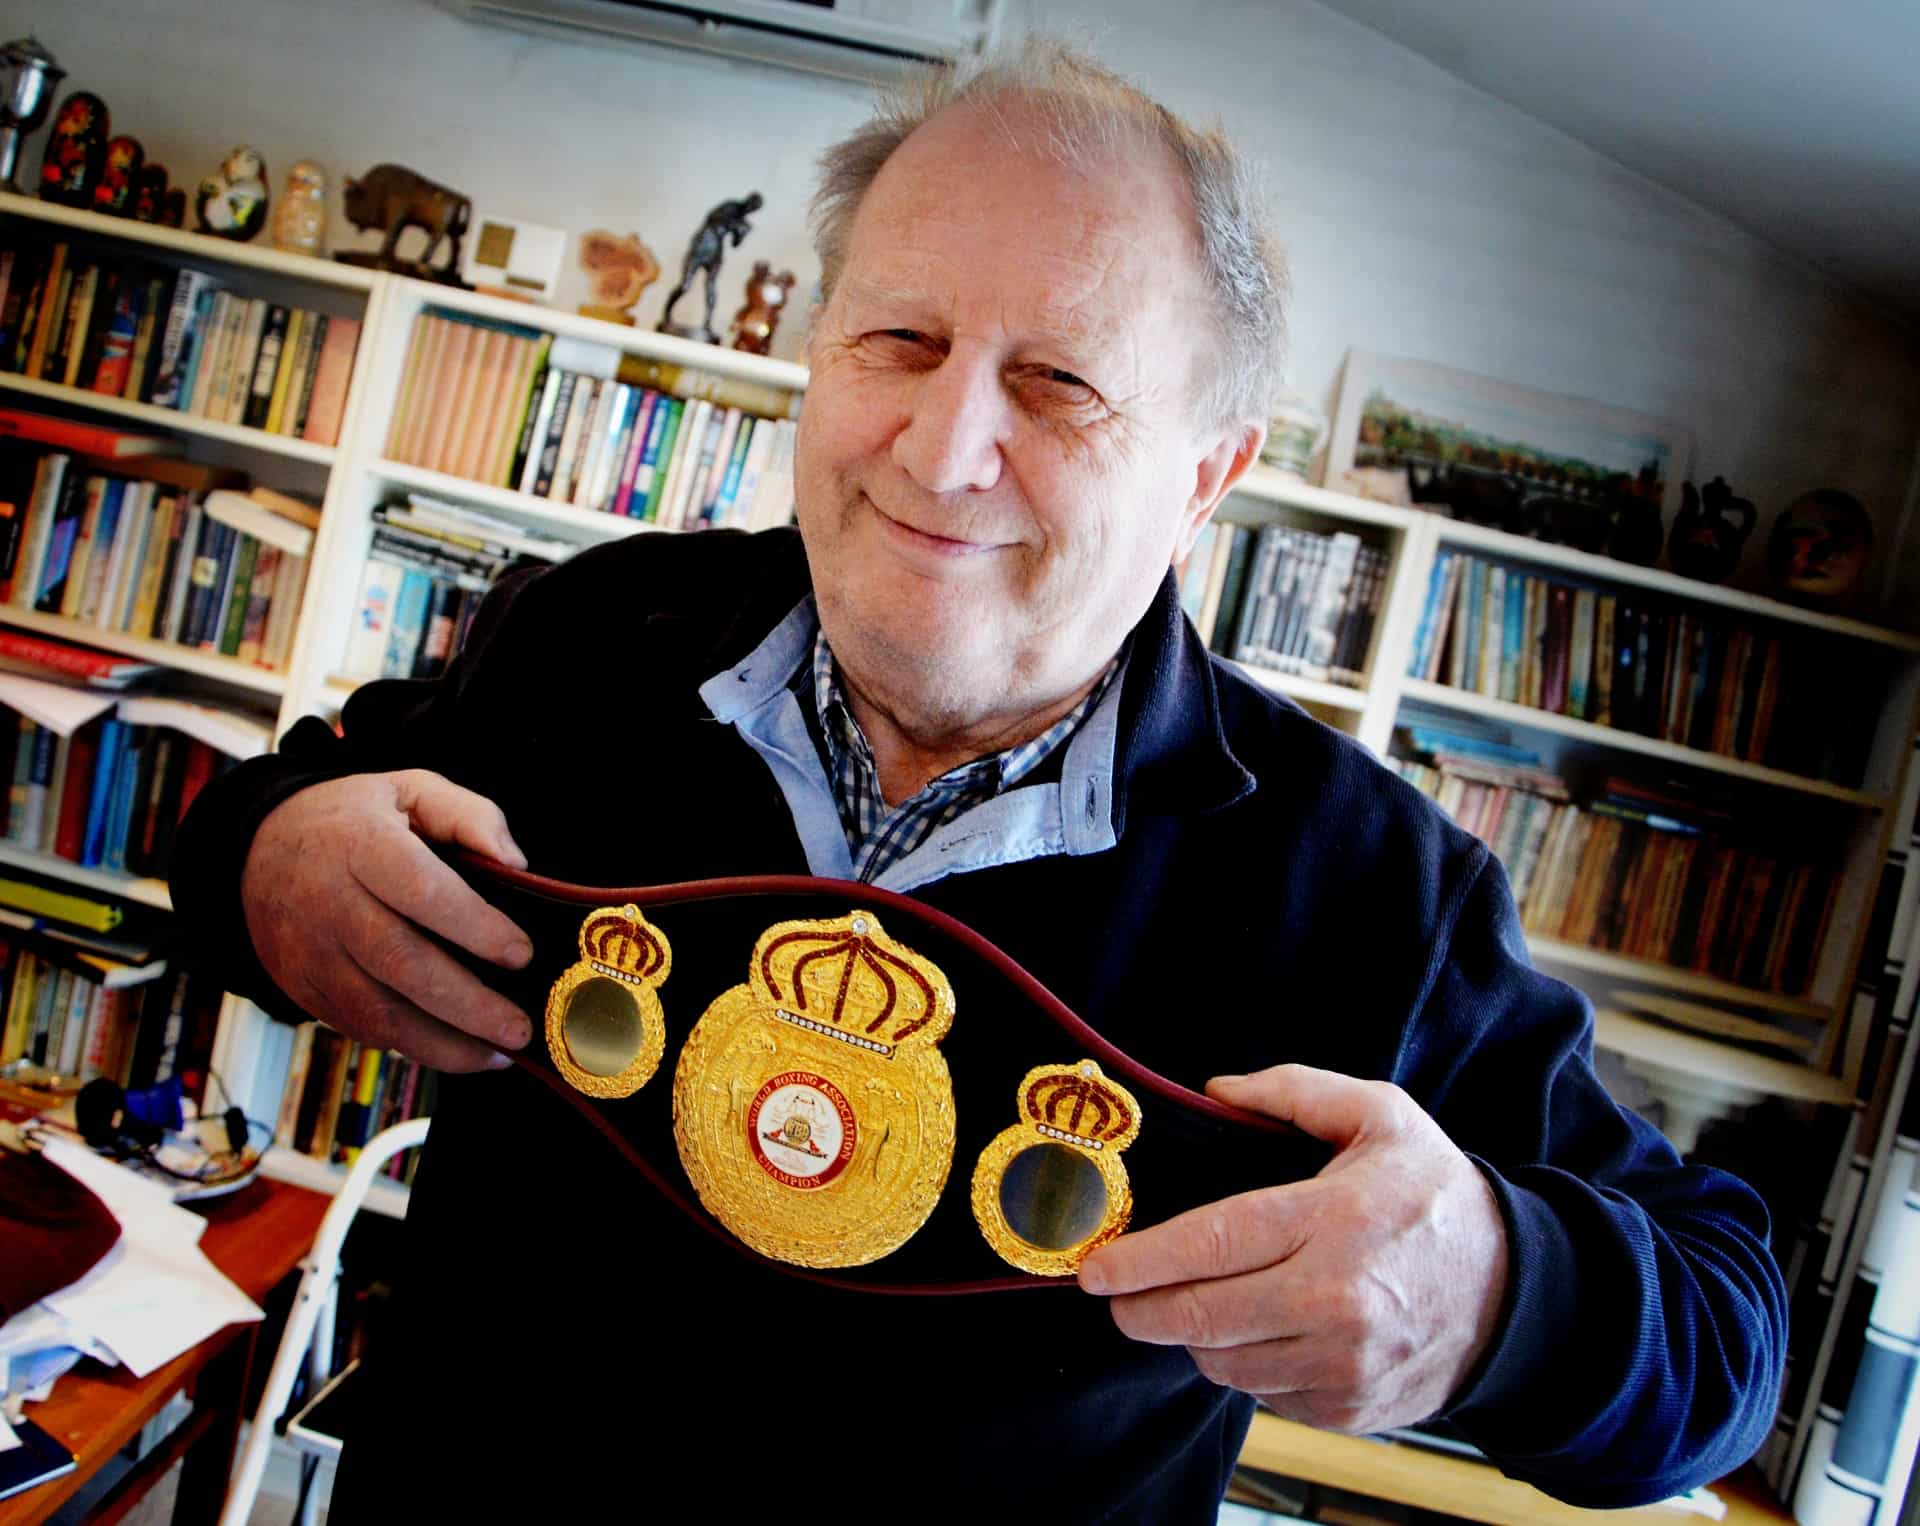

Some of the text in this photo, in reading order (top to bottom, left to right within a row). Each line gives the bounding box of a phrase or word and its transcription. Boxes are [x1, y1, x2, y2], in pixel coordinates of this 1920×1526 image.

[749, 1074, 856, 1161] WORLD BOXING ASSOCIATION
[758, 1154, 822, 1188] CHAMPION
